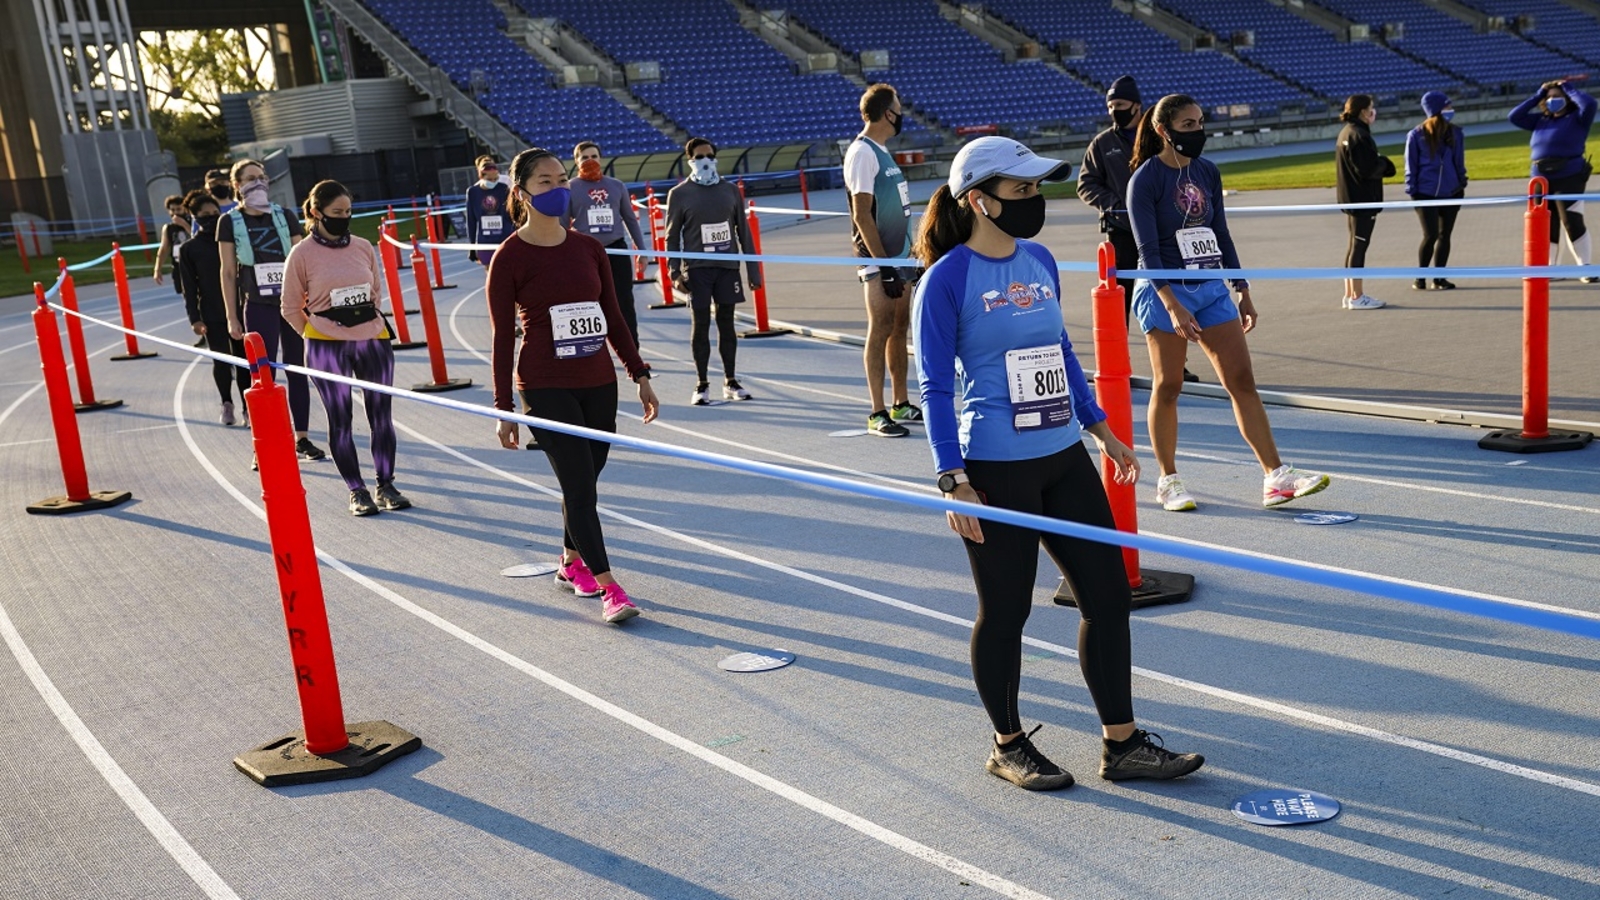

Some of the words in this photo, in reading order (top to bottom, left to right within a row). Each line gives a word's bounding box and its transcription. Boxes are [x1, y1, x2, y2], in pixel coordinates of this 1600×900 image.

[711, 230, 728, 242] 8027
[1191, 239, 1219, 256] 8042
[267, 272, 283, 283] 832
[734, 281, 740, 294] 5
[569, 316, 602, 336] 8316
[1034, 367, 1066, 397] 8013
[276, 553, 315, 687] NYRR
[1272, 798, 1289, 816] HERE
[1286, 798, 1304, 816] WAIT
[1298, 793, 1320, 819] PLEASE
